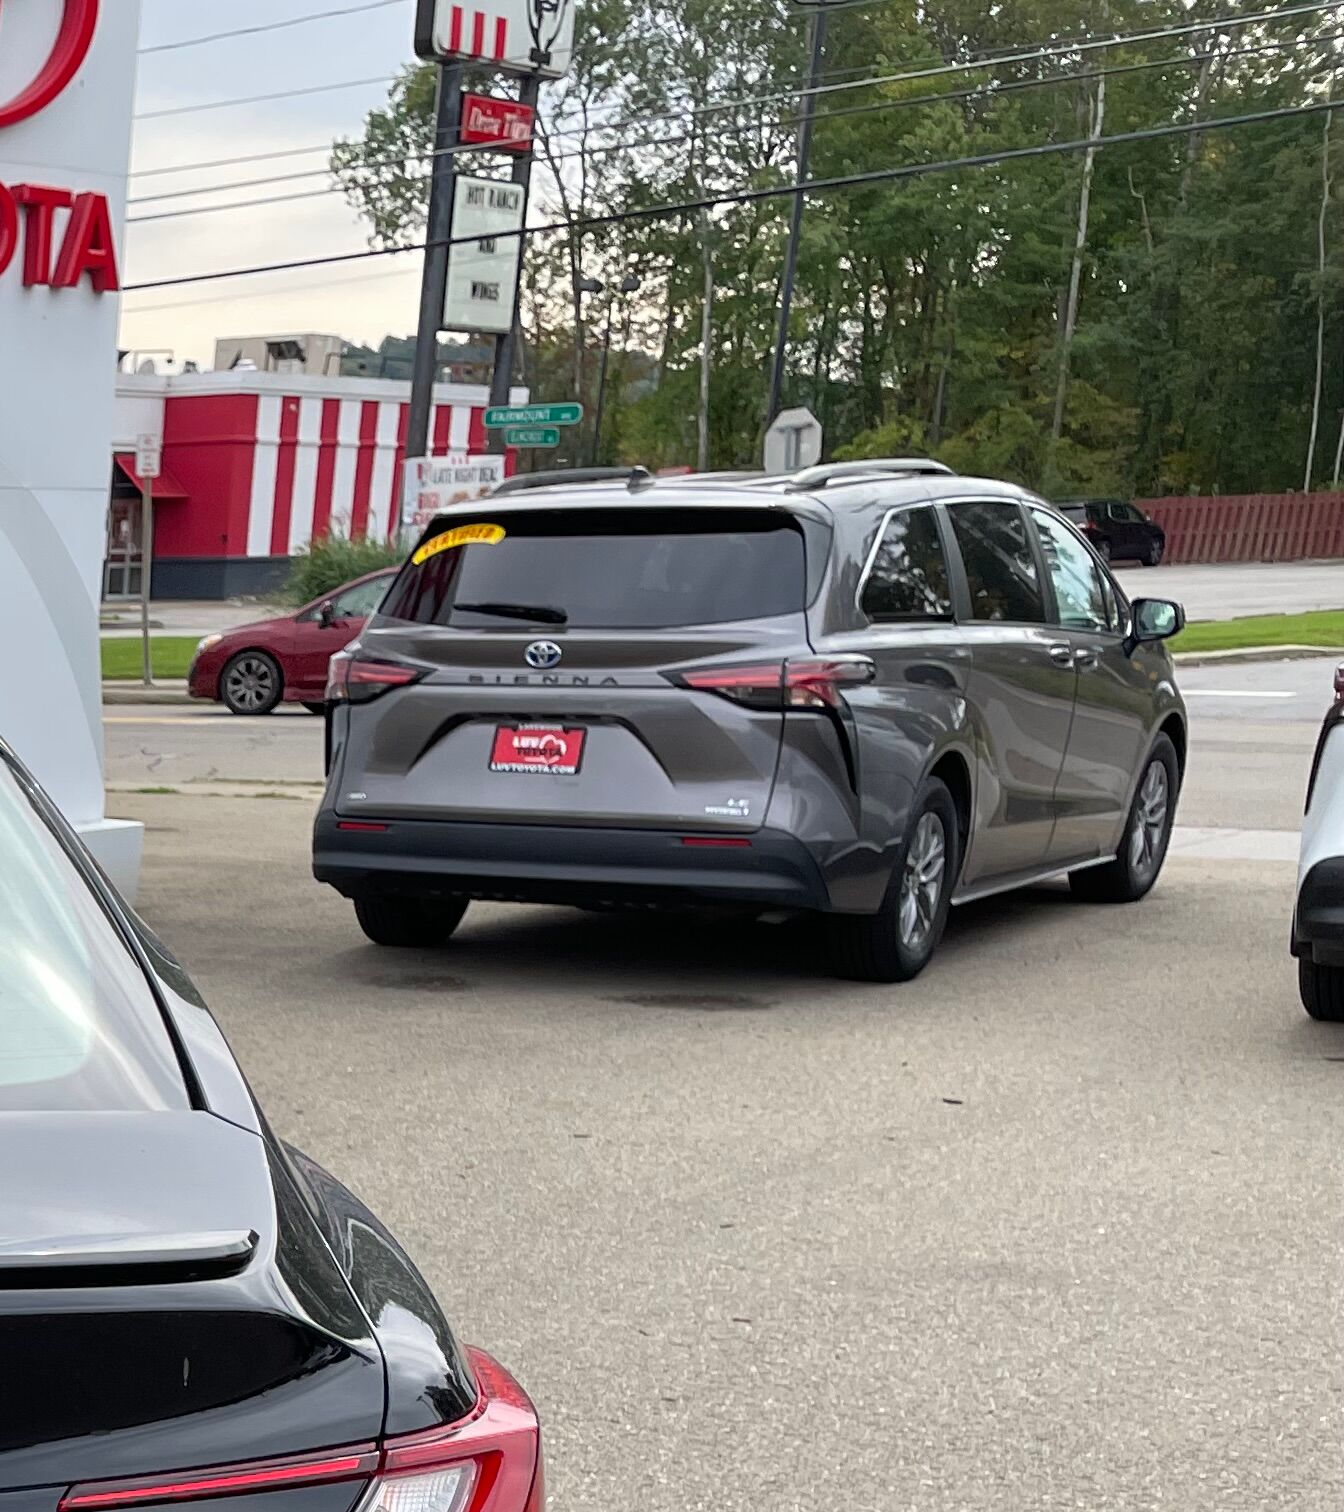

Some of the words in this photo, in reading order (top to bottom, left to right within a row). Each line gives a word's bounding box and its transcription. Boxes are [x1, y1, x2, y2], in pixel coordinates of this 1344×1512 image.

[468, 107, 502, 136] Drive
[491, 409, 550, 423] FAIRMOUNT
[468, 674, 619, 687] SIENNA
[512, 736, 540, 748] LUV
